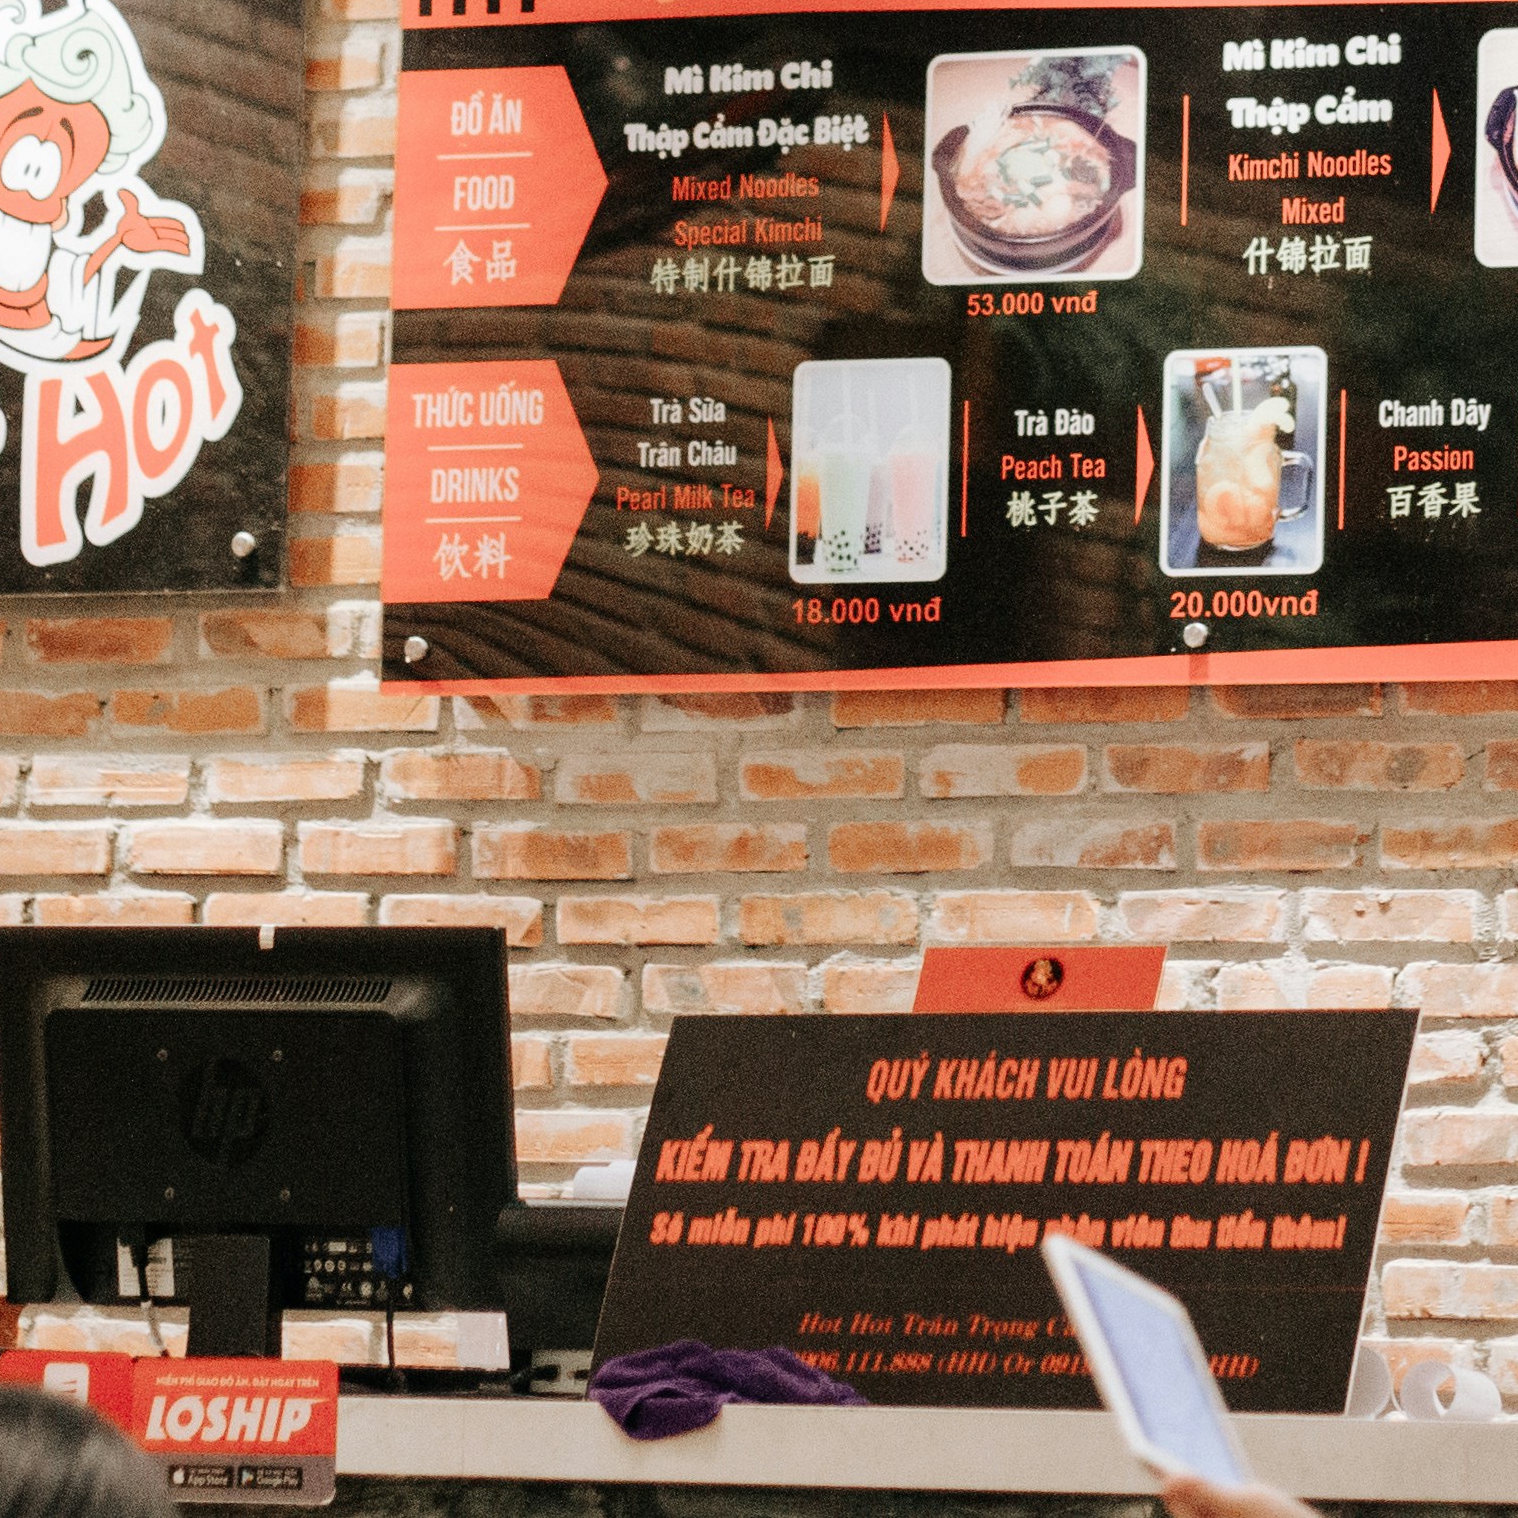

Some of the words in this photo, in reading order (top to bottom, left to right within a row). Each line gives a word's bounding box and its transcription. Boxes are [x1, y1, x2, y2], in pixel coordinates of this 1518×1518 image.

[1222, 39, 1266, 72] Mì
[1270, 37, 1340, 70] Kim
[1345, 33, 1402, 66] Chi
[664, 63, 704, 95] Mì
[710, 63, 775, 93] Kim
[781, 59, 833, 90] Chi
[488, 93, 523, 135] ĂN
[1226, 95, 1311, 136] Thập
[624, 121, 689, 160] Thập
[757, 118, 810, 155] Đặc
[814, 114, 870, 152] Biệt
[1227, 152, 1300, 182] Kimchi
[1307, 149, 1392, 178] Noodles
[452, 175, 515, 211] FOOD
[672, 174, 732, 202] Mixed
[739, 171, 821, 200] Noodles
[1281, 196, 1345, 225] Mixed
[673, 218, 748, 251] Special
[753, 215, 824, 245] Kimchi
[443, 238, 517, 286] 食品
[1243, 234, 1374, 276] 什锦拉面
[649, 253, 836, 295] 特制什锦拉面
[966, 291, 1044, 318] 53.000
[1050, 288, 1098, 315] vnđ
[412, 386, 474, 428] THỨC
[479, 380, 544, 426] UỐNG
[650, 397, 682, 425] Trà
[1014, 408, 1049, 437] Trà
[1053, 406, 1096, 436] Đào
[1379, 399, 1445, 429] Chanh
[1449, 397, 1492, 432] Dây
[27, 297, 234, 558] Hot
[638, 441, 680, 469] Trân
[687, 439, 737, 467] Châu
[1001, 454, 1063, 480] Peach
[1069, 453, 1106, 478] Tea
[1393, 444, 1475, 472] Passion
[431, 467, 520, 503] DRINKS
[616, 485, 667, 512] Pearl
[673, 484, 714, 510] Milk
[721, 483, 756, 509] Tea
[1385, 481, 1483, 521] 百香果
[1005, 490, 1099, 527] 桃子茶
[433, 531, 512, 582] 饮料
[624, 520, 746, 559] 珍珠奶茶
[791, 597, 880, 625] 18.000
[888, 595, 943, 622] vnđ
[932, 1049, 1041, 1101] KHÁCH
[1046, 1058, 1099, 1100] VUI
[1102, 1047, 1189, 1100] LÒNG
[737, 1139, 790, 1182] TRA
[906, 1131, 945, 1182] VÀ
[951, 1139, 1050, 1183] THANH
[1053, 1130, 1134, 1183] TOÁN
[1137, 1138, 1213, 1184] THEO
[1215, 1129, 1279, 1184] HOÁ
[802, 1212, 870, 1248] 100%
[799, 1313, 842, 1335] Hot
[850, 1313, 893, 1335] Hot
[146, 1395, 327, 1442] LOSHIP
